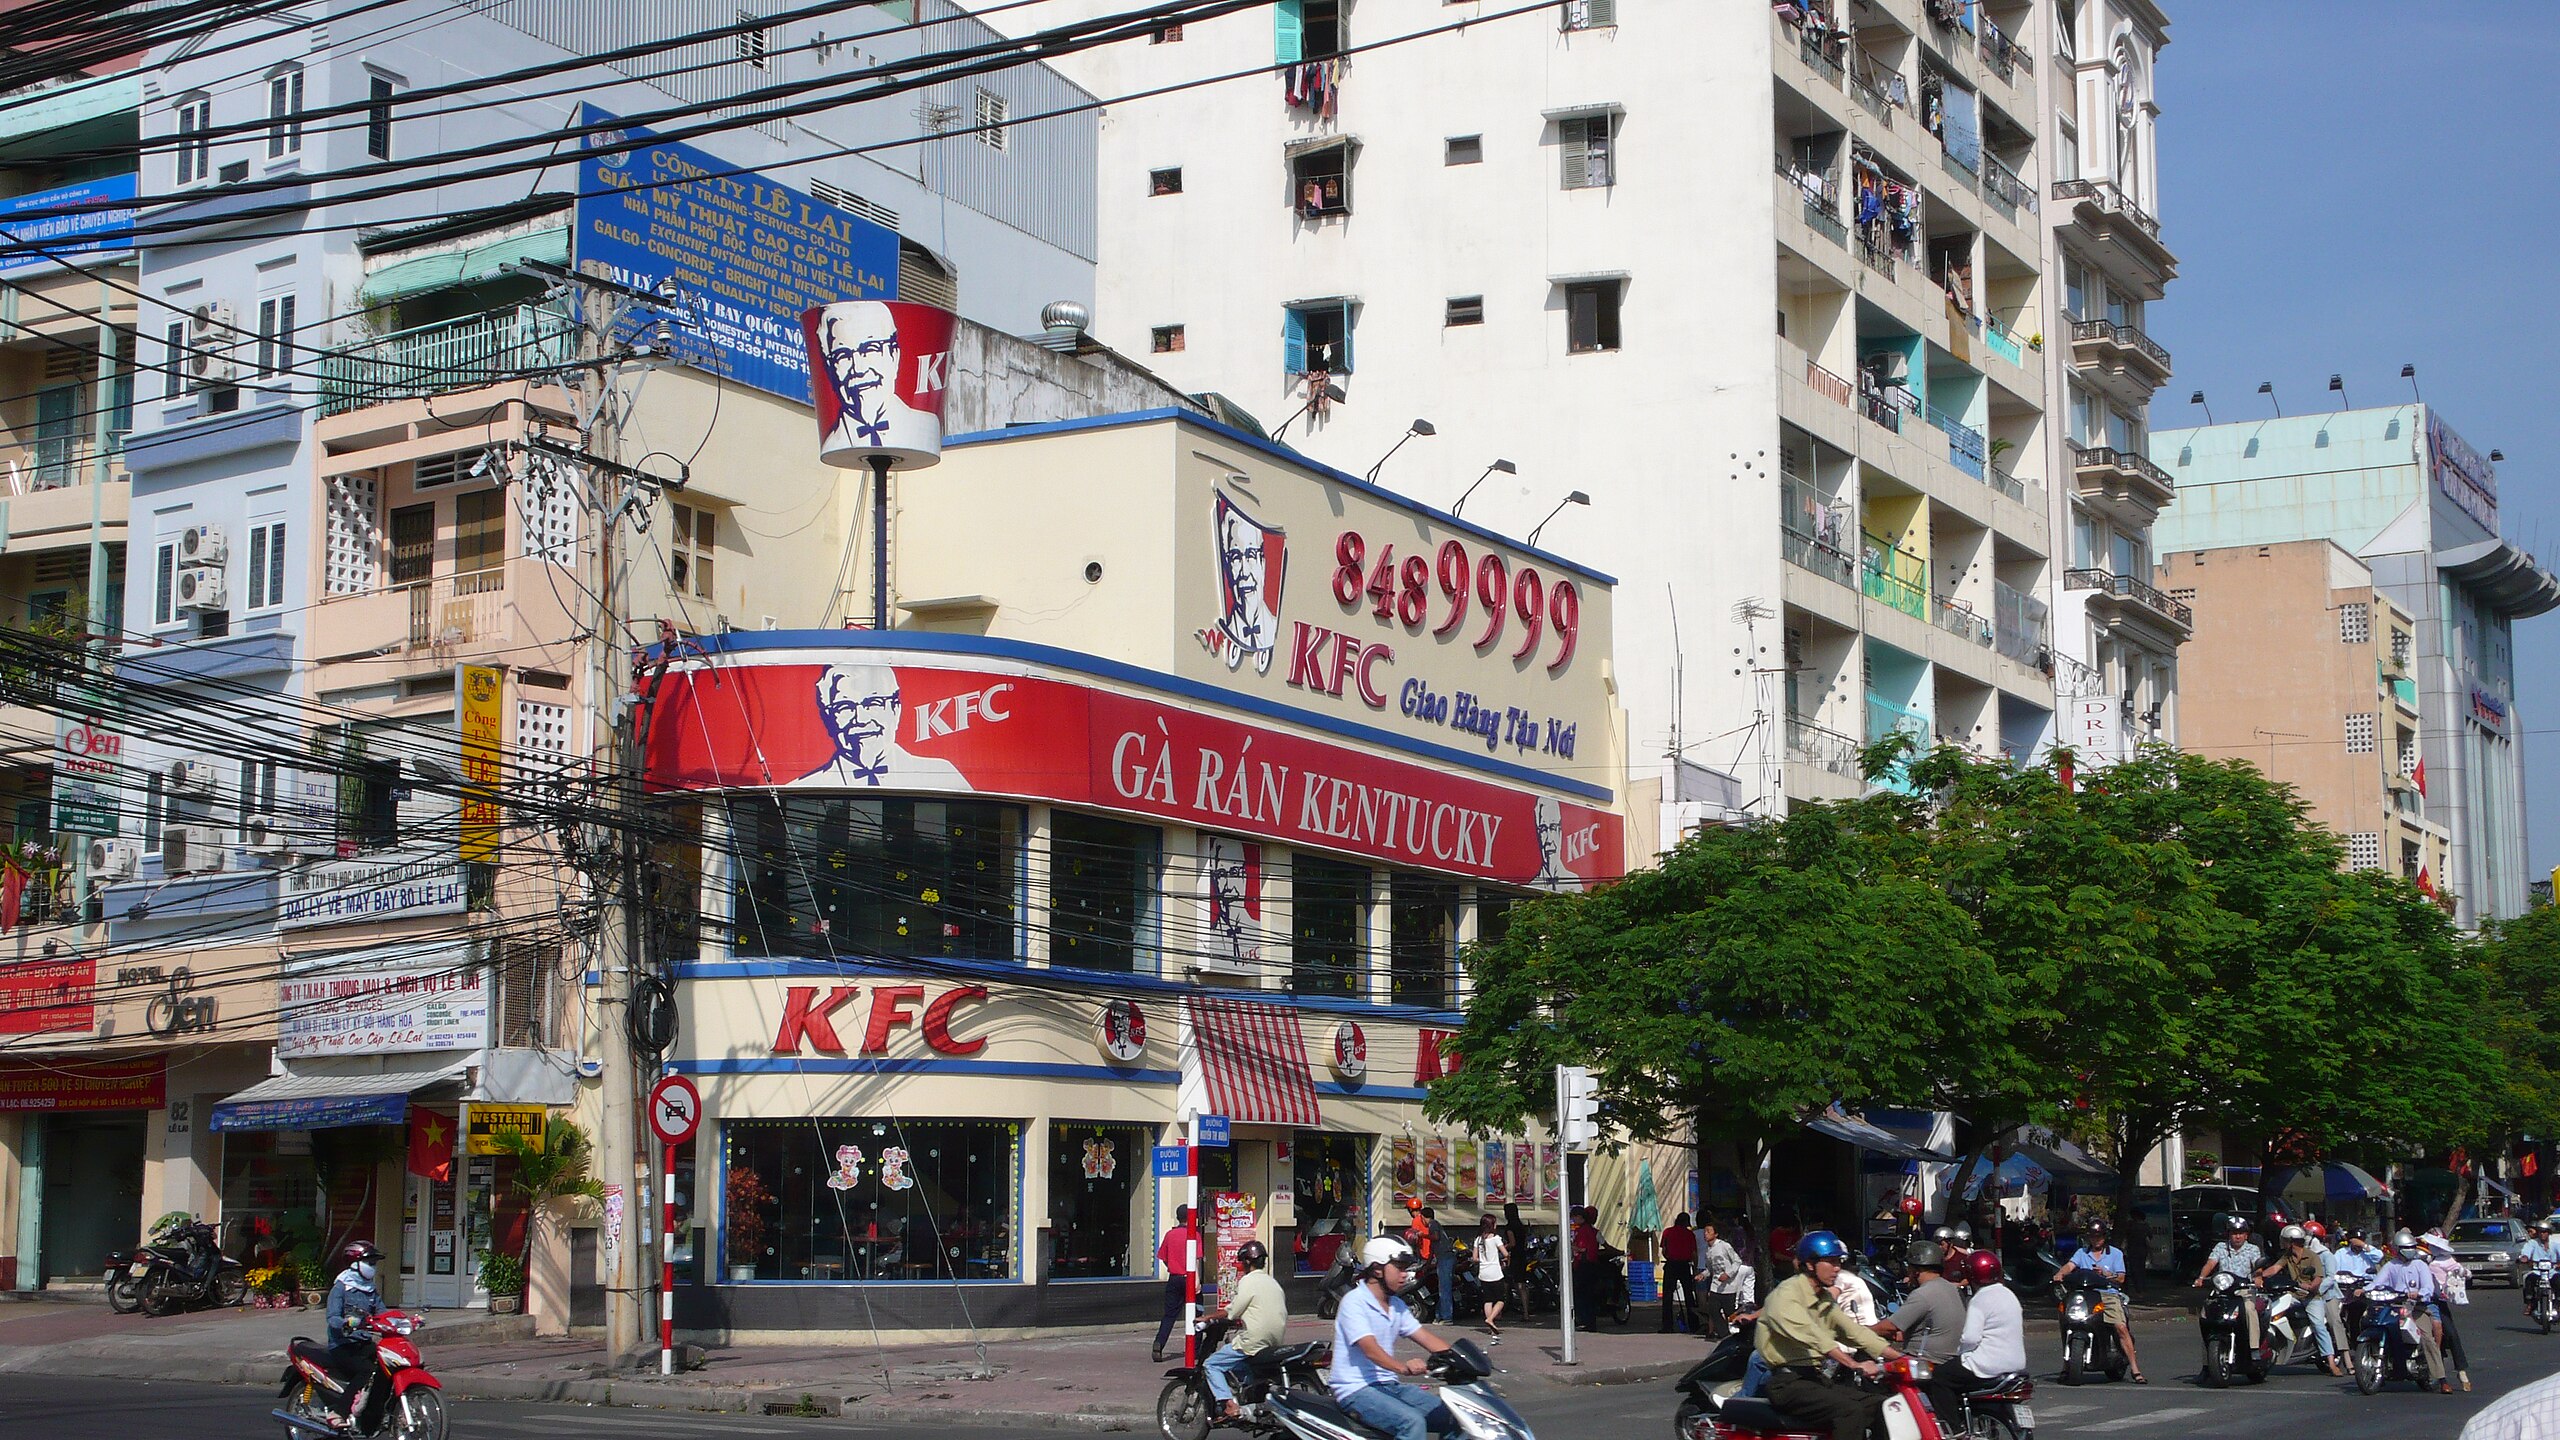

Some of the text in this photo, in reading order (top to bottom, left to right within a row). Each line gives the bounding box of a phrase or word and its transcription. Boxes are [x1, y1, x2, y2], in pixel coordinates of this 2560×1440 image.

[652, 150, 852, 244] CÔNG TY LÊ LAI
[40, 220, 55, 238] VIÊN
[653, 187, 682, 211] MỸ
[753, 228, 789, 252] CAO
[794, 244, 829, 266] CẤP
[833, 260, 853, 278] LÊ
[858, 269, 885, 291] LAI
[623, 195, 649, 217] NHÀ
[654, 207, 686, 230] PHÂN
[690, 221, 718, 243] PHỐI
[751, 245, 787, 269] QUYỀN
[811, 269, 835, 288] VIỆT
[838, 280, 862, 298] NAM
[650, 223, 837, 302] EXCLUSIVE DISTRIBUTOR IN VIETNAM
[675, 266, 791, 318] HIGH QUALITY ISO
[726, 267, 768, 294] BRIGHT
[771, 286, 802, 308] LINEN
[633, 273, 653, 291] LÝ
[715, 302, 742, 323] BAY
[745, 316, 781, 337] QUỐC
[703, 317, 751, 340] DOMESTIC
[755, 335, 762, 346] &
[1332, 530, 1579, 671] 8489999
[1286, 621, 1576, 759] KFC Giao Hàng Tận Nơi
[464, 711, 496, 729] Công
[914, 684, 1010, 743] KFC
[65, 714, 120, 756] Sen
[66, 759, 116, 774] HOTEL
[469, 752, 493, 784] LÊ
[1112, 716, 1503, 869] GÀ RÁN KENTUCKY
[1566, 822, 1600, 864] KFC
[290, 875, 310, 891] TRUNG
[312, 871, 326, 889] TÂM
[328, 872, 338, 887] TIN
[380, 867, 384, 882] &
[346, 888, 370, 913] MÁY
[374, 889, 398, 911] BAY
[400, 888, 414, 908] 80
[419, 881, 434, 905] LÊ
[438, 883, 458, 904] LAI
[77, 966, 89, 976] AN
[117, 966, 163, 985] HOTEL
[294, 984, 301, 1001] TY
[385, 977, 392, 994] &
[396, 976, 418, 996] DỊCH
[423, 974, 436, 995] VỤ
[442, 971, 456, 991] LÊ
[461, 972, 480, 990] LAI
[147, 966, 218, 1035] Sen
[771, 986, 989, 1055] KFC
[348, 1033, 363, 1046] Cao
[367, 1032, 384, 1047] Cấp
[388, 1031, 403, 1044] Lê
[404, 1030, 423, 1043] Lai
[171, 1102, 189, 1120] 82
[471, 1112, 530, 1124] WESTERN
[489, 1124, 530, 1134] UNION
[1160, 1149, 1180, 1158] ĐƯỜNG
[1162, 1160, 1179, 1172] LÊ LAI
